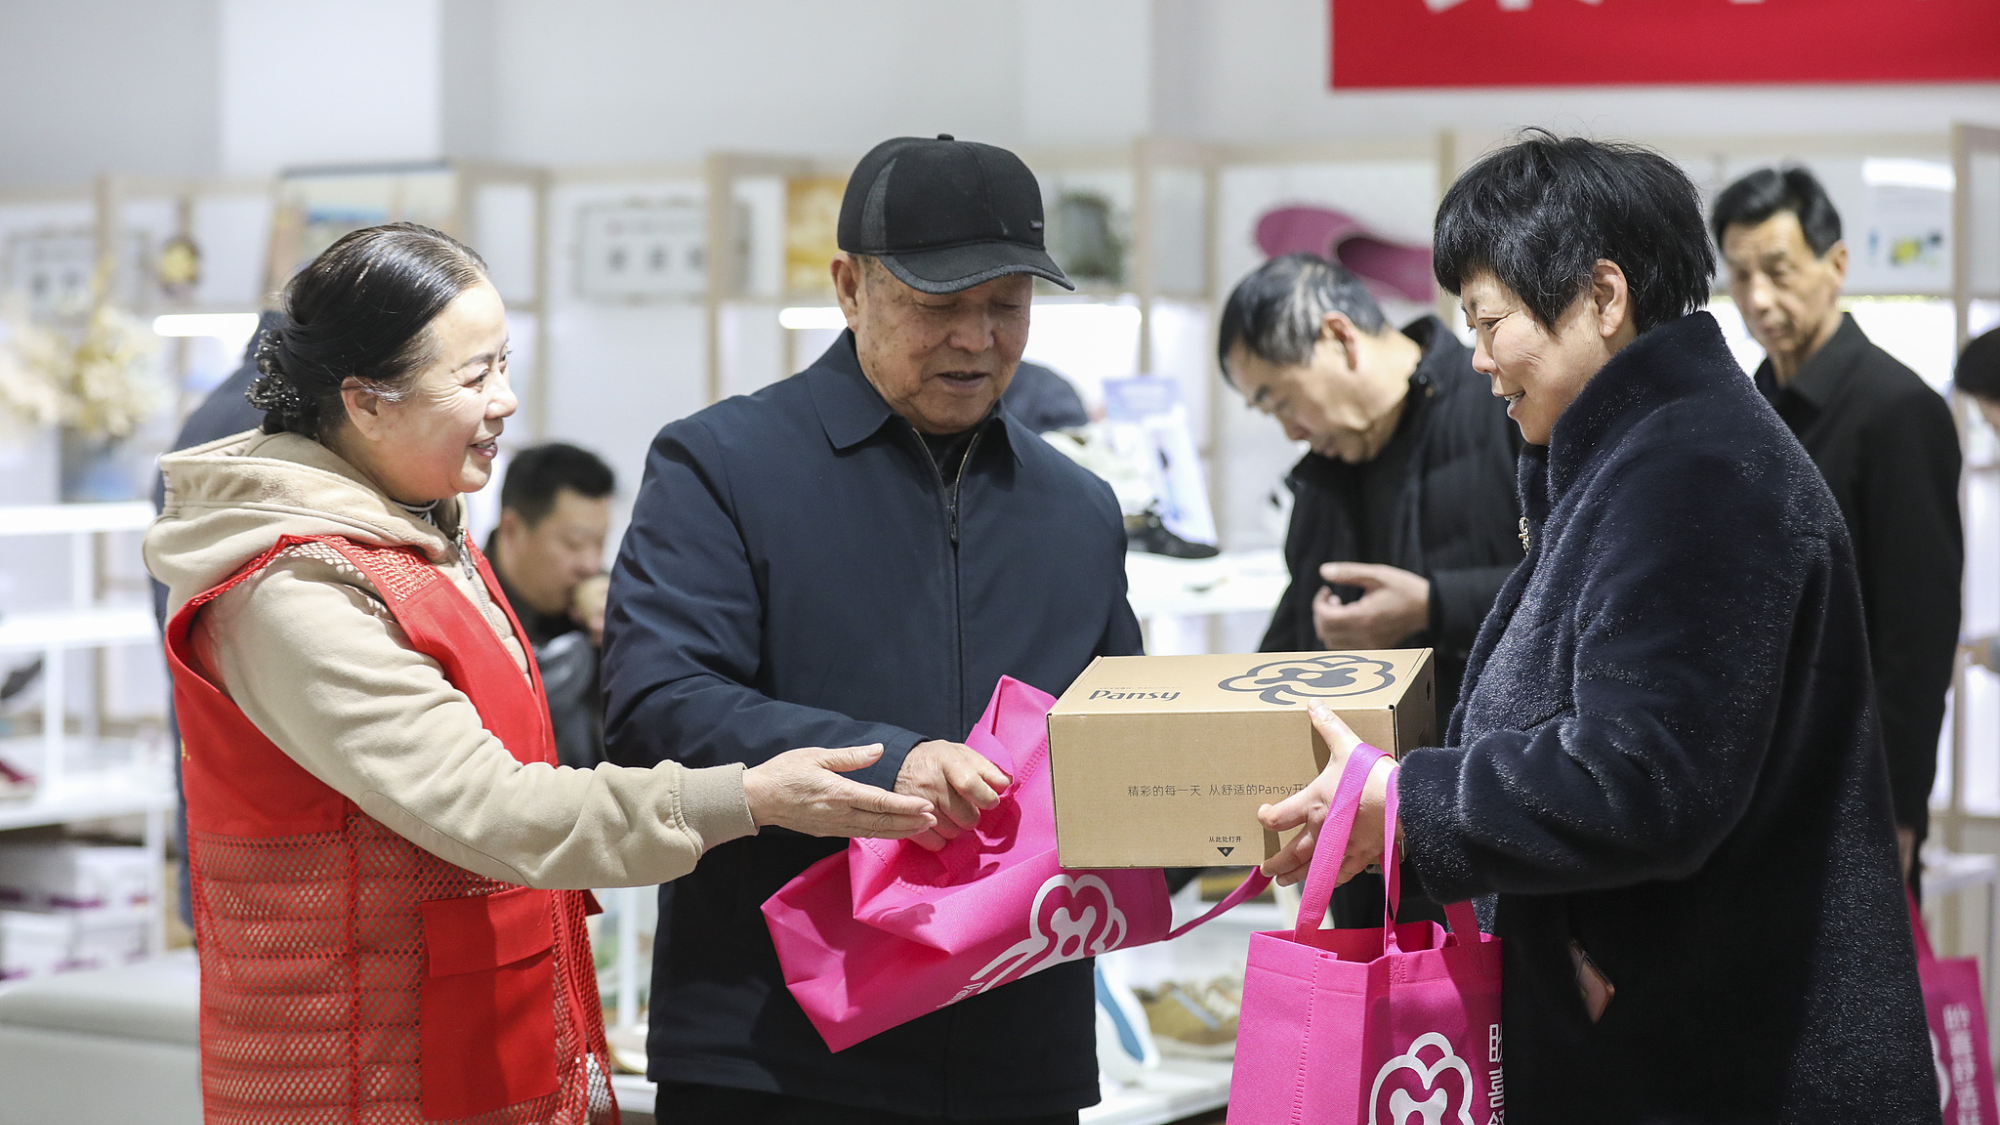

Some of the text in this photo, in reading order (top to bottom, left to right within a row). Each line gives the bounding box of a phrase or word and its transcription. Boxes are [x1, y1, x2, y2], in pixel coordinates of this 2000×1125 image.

[1088, 690, 1181, 701] Pansy
[1127, 784, 1202, 797] 精彩的每一天
[1208, 835, 1242, 843] 从此处打开
